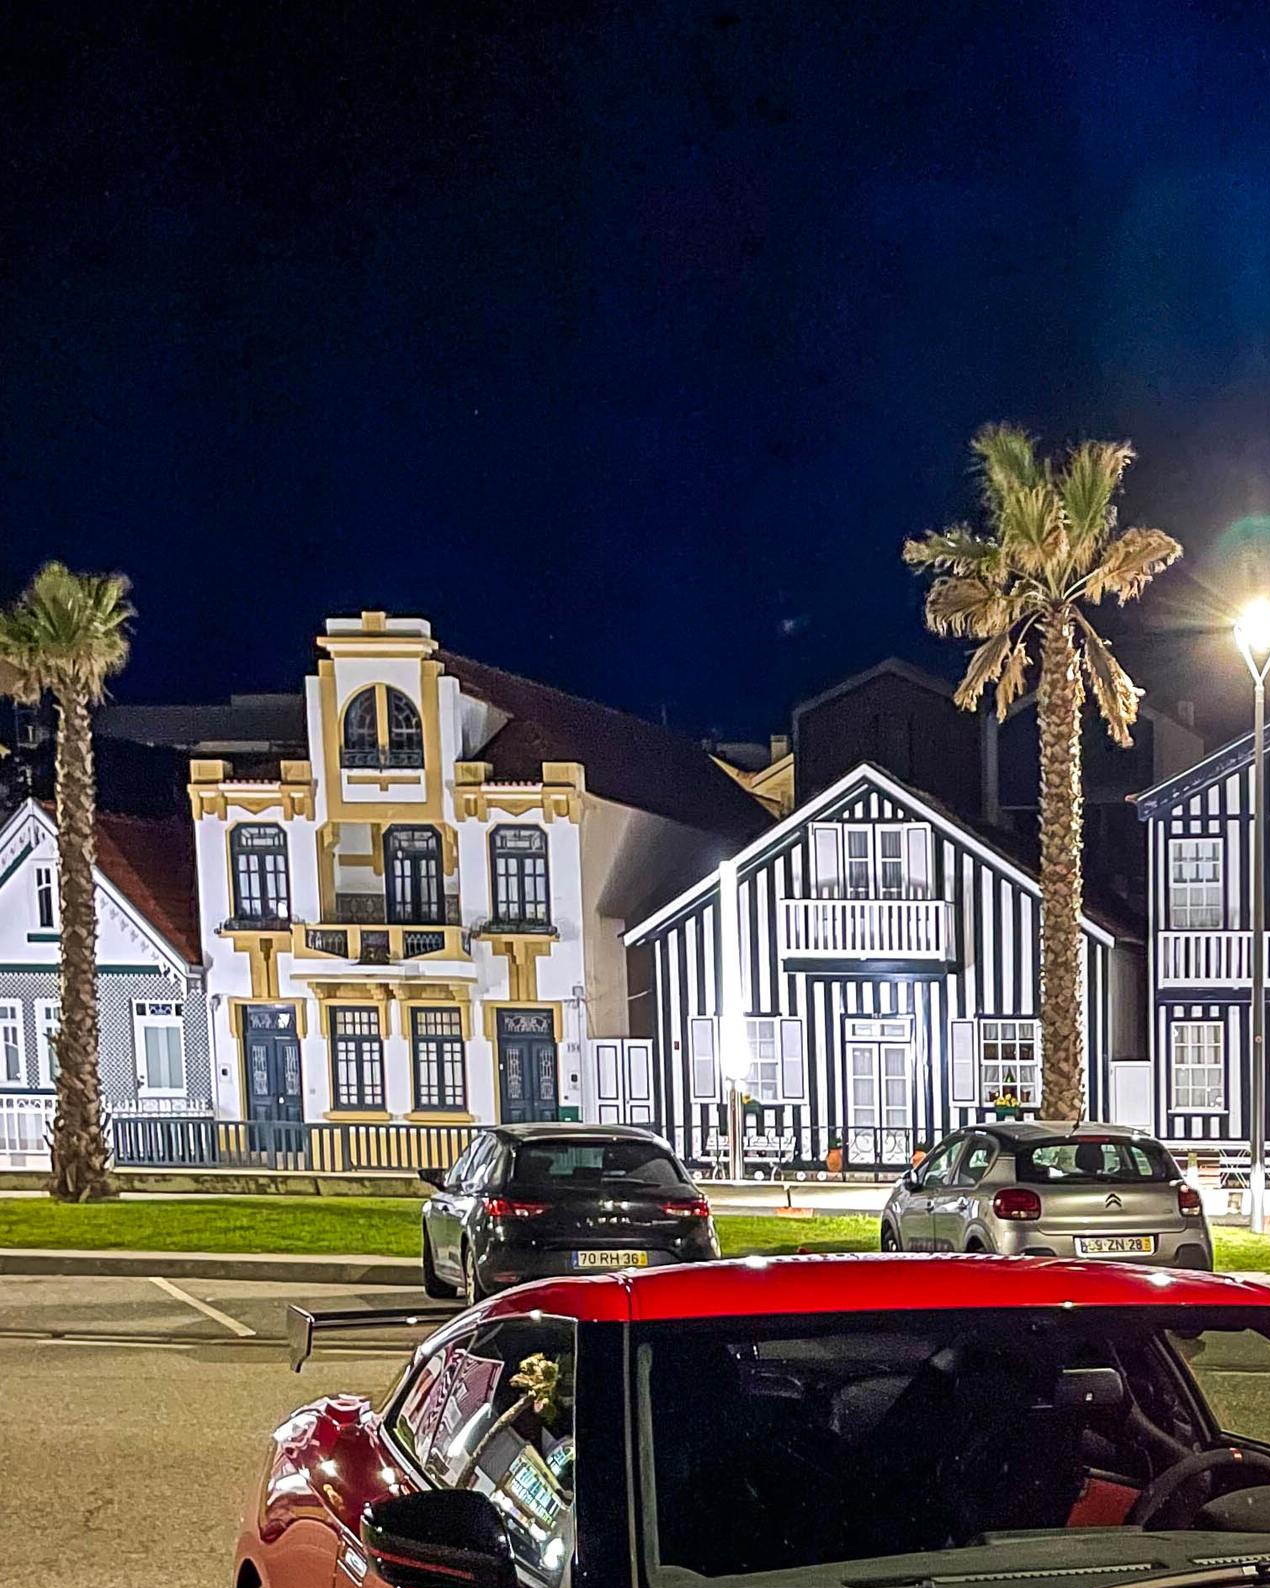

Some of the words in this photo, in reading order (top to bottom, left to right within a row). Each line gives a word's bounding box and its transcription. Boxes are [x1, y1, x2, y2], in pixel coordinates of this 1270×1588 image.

[580, 1253, 596, 1265] 70
[600, 1253, 619, 1265] RH
[623, 1253, 639, 1265] 36
